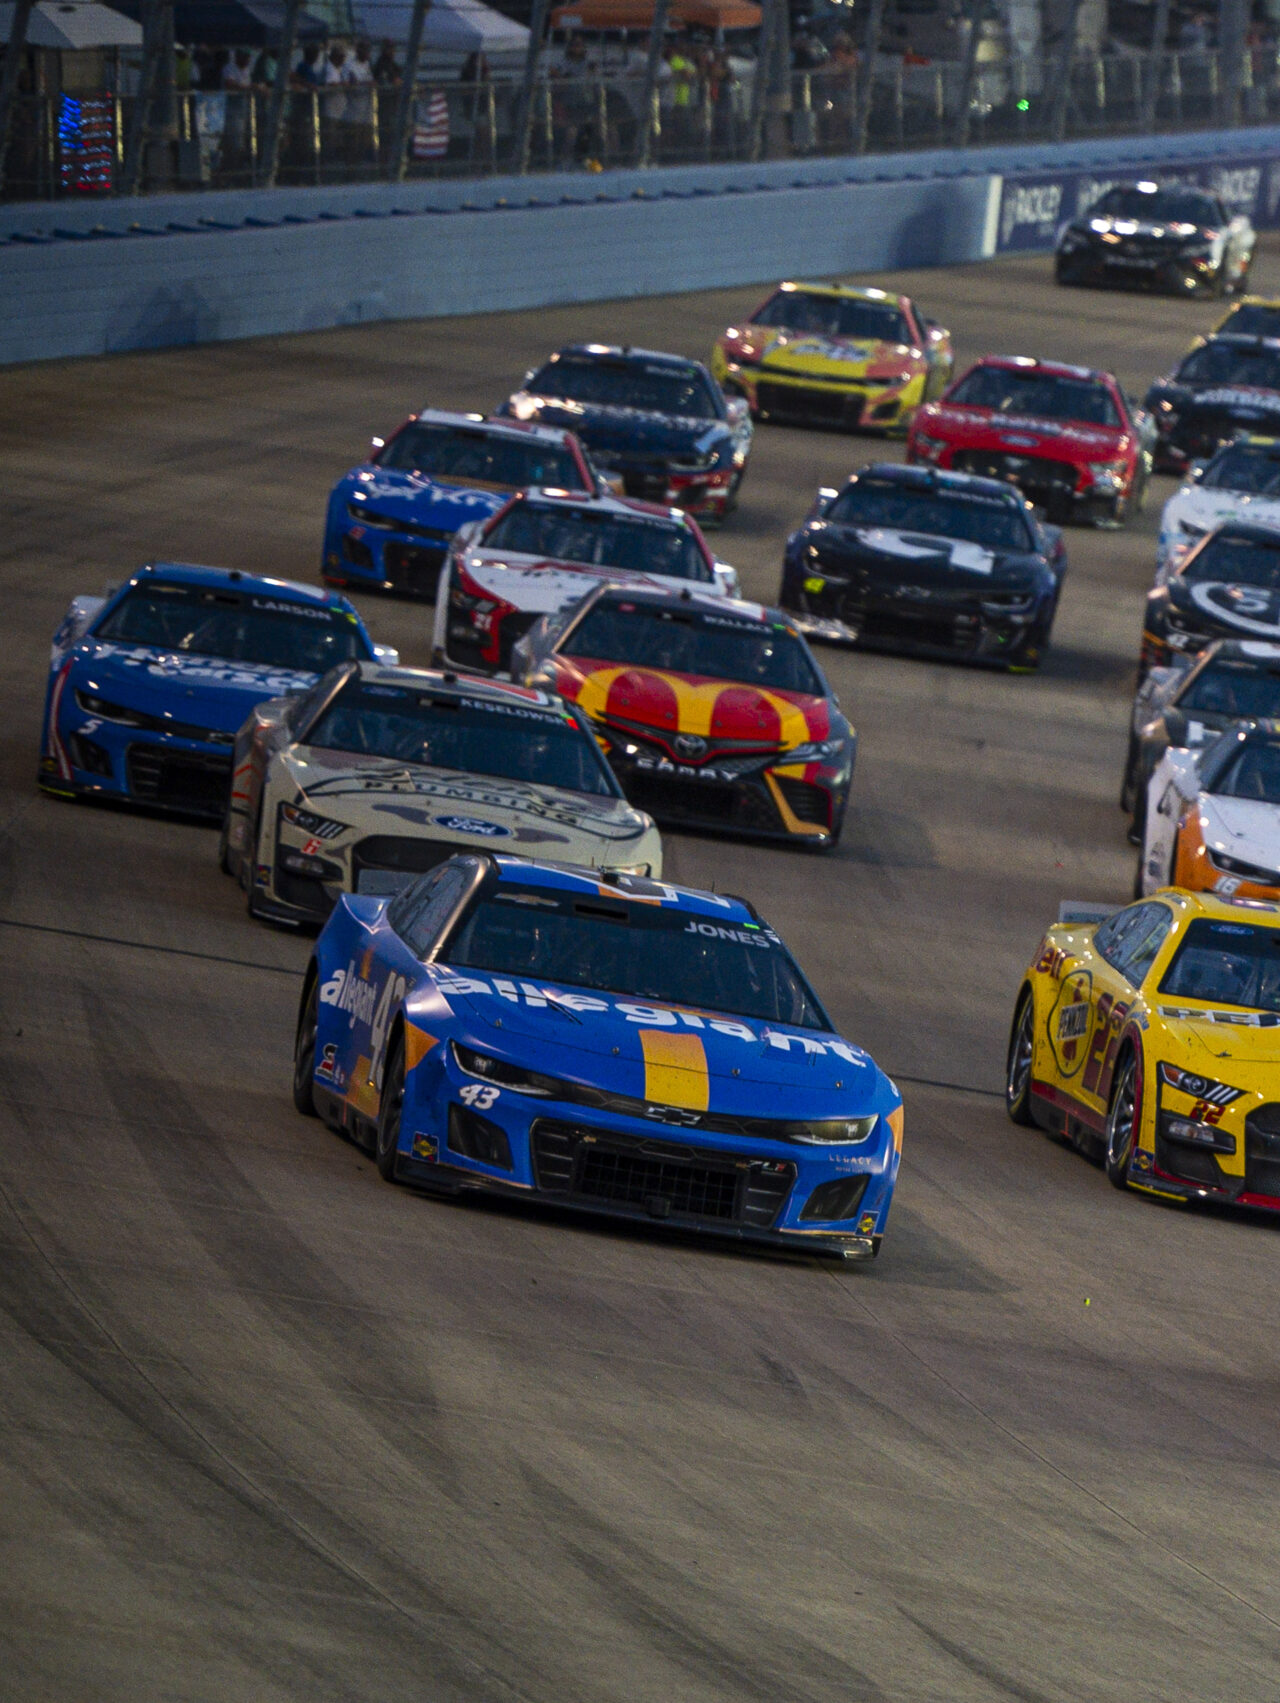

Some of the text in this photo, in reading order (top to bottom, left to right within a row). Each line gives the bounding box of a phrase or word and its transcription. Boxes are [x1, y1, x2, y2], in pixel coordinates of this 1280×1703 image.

[252, 599, 333, 621] LARSON
[703, 614, 773, 635] WALLACE
[459, 697, 561, 725] KESELOWSK
[78, 718, 102, 735] 5
[636, 758, 739, 782] CAMRY
[447, 817, 498, 836] Ford
[303, 838, 322, 856] 6
[684, 921, 771, 949] JONES
[436, 977, 868, 1069] allegiant
[459, 1084, 501, 1110] 43
[1189, 1099, 1226, 1125] 22
[828, 1153, 873, 1166] LEGACY
